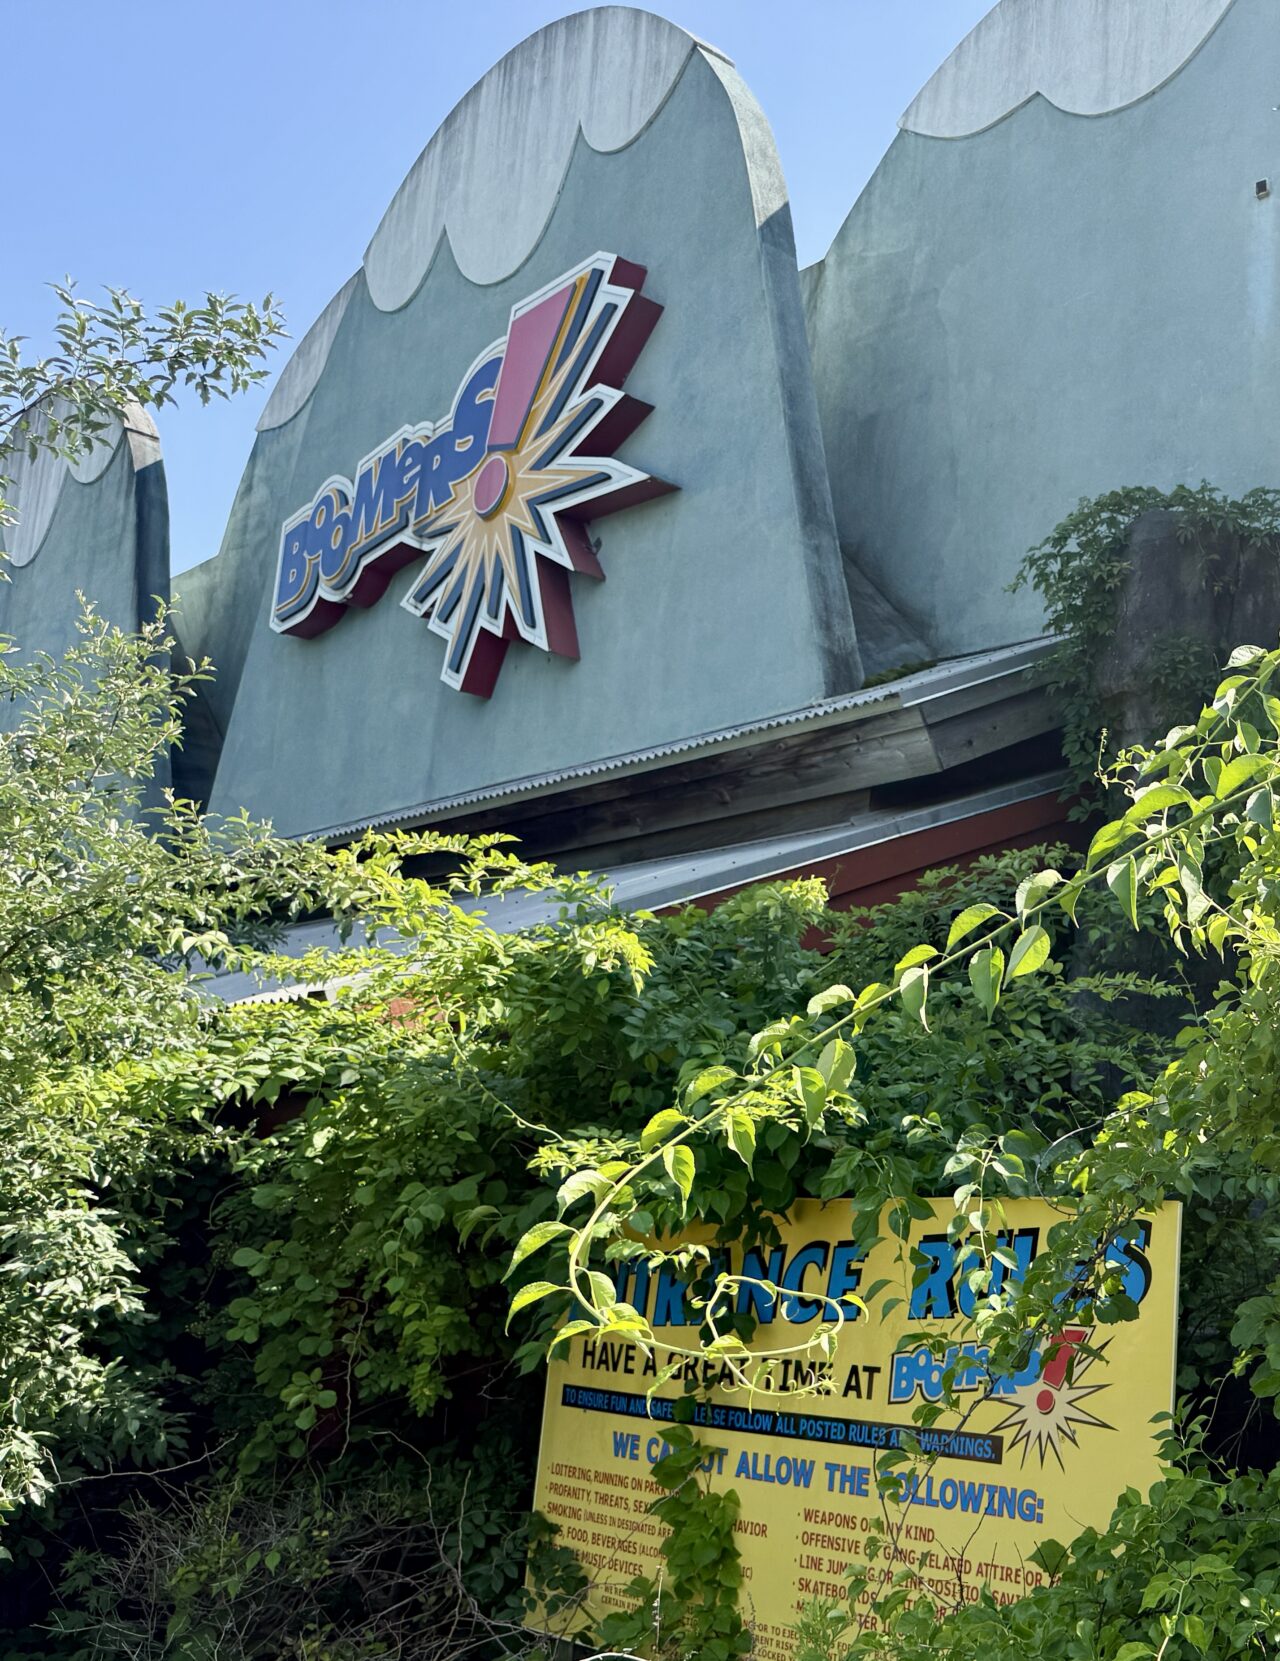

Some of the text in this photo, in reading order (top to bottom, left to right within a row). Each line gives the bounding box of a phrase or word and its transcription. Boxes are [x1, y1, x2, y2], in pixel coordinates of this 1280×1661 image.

[582, 1339, 637, 1375] HAVE
[642, 1345, 657, 1378] A
[666, 1351, 750, 1388] GREAT
[842, 1364, 881, 1401] AT
[565, 1387, 577, 1404] TO
[577, 1389, 609, 1410] ENSURE
[610, 1394, 627, 1412] FUN
[629, 1397, 647, 1415] AND
[690, 1405, 726, 1427] LESE
[728, 1410, 774, 1432] FOLLOW
[776, 1417, 796, 1435] ALL
[799, 1419, 846, 1441] POSTED
[848, 1424, 887, 1446] RULES
[920, 1431, 996, 1460] WARNINGS.
[613, 1431, 641, 1461] WE
[646, 1437, 729, 1475] CAOT
[734, 1450, 816, 1489] ALLOW
[824, 1461, 871, 1498] THE
[549, 1482, 592, 1505] PROFANITY,
[594, 1491, 631, 1513] THREATS,
[594, 1472, 629, 1490] RUNNING
[631, 1478, 642, 1492] ON
[546, 1501, 583, 1521] SMOKING
[803, 1508, 858, 1532] WEAPONS
[905, 1524, 936, 1543] KIND
[566, 1525, 589, 1545] FOOD,
[591, 1532, 638, 1555] BEVERAGES
[581, 1551, 607, 1569] MUSIC
[608, 1556, 643, 1577] DEVICES
[801, 1531, 861, 1555] OFFENSIVE
[883, 1545, 973, 1575] GANG-ELATED
[975, 1562, 1022, 1585] ATTIRE
[1025, 1571, 1043, 1587] OR
[798, 1577, 877, 1605] SKATEBODS
[799, 1554, 824, 1572] LINE
[898, 1573, 925, 1591] INE
[927, 1579, 985, 1603] POSITIO
[782, 1627, 803, 1641] EJEC
